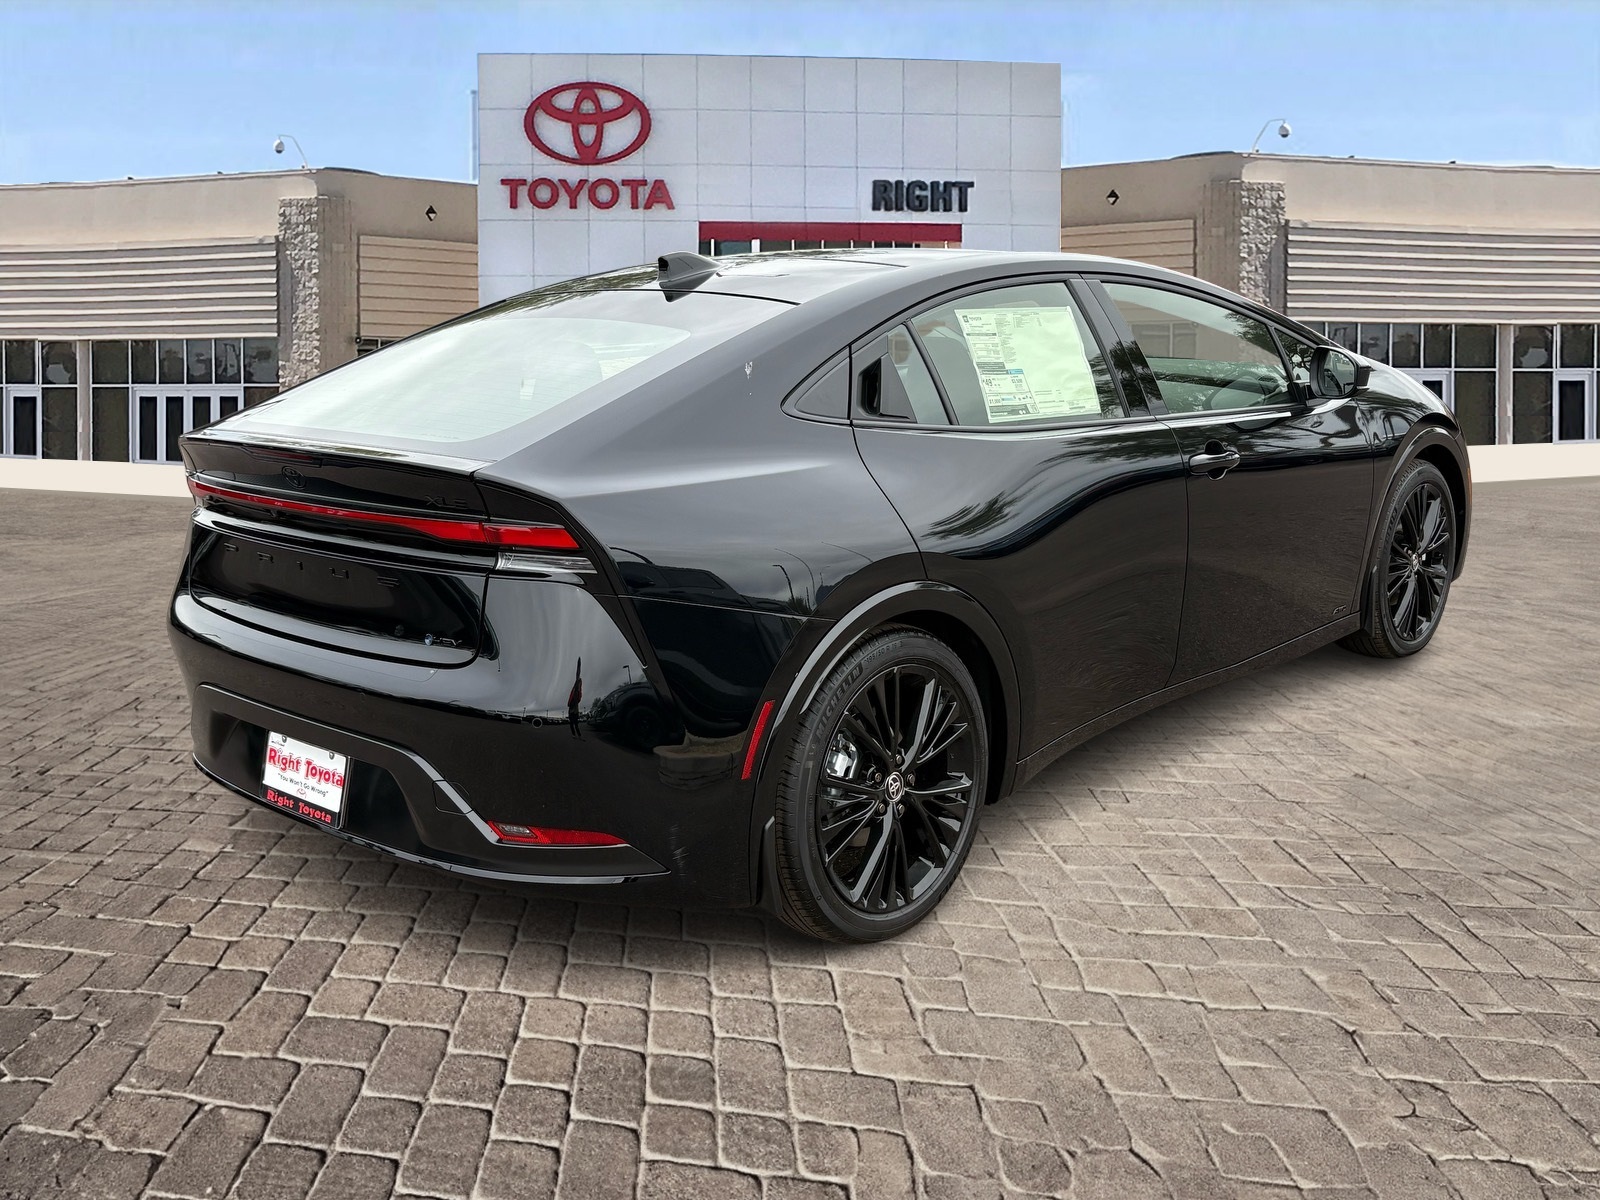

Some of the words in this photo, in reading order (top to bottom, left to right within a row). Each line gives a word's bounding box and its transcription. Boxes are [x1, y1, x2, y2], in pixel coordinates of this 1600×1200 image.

[500, 178, 676, 211] TOYOTA
[872, 179, 975, 213] RIGHT
[424, 495, 469, 510] XLE
[223, 542, 400, 588] PRIUS
[816, 665, 862, 739] MICHELIN
[268, 747, 301, 772] Right
[305, 760, 344, 786] Toyota
[303, 782, 310, 790] Go
[267, 790, 294, 807] Right
[299, 802, 332, 822] Toyota
